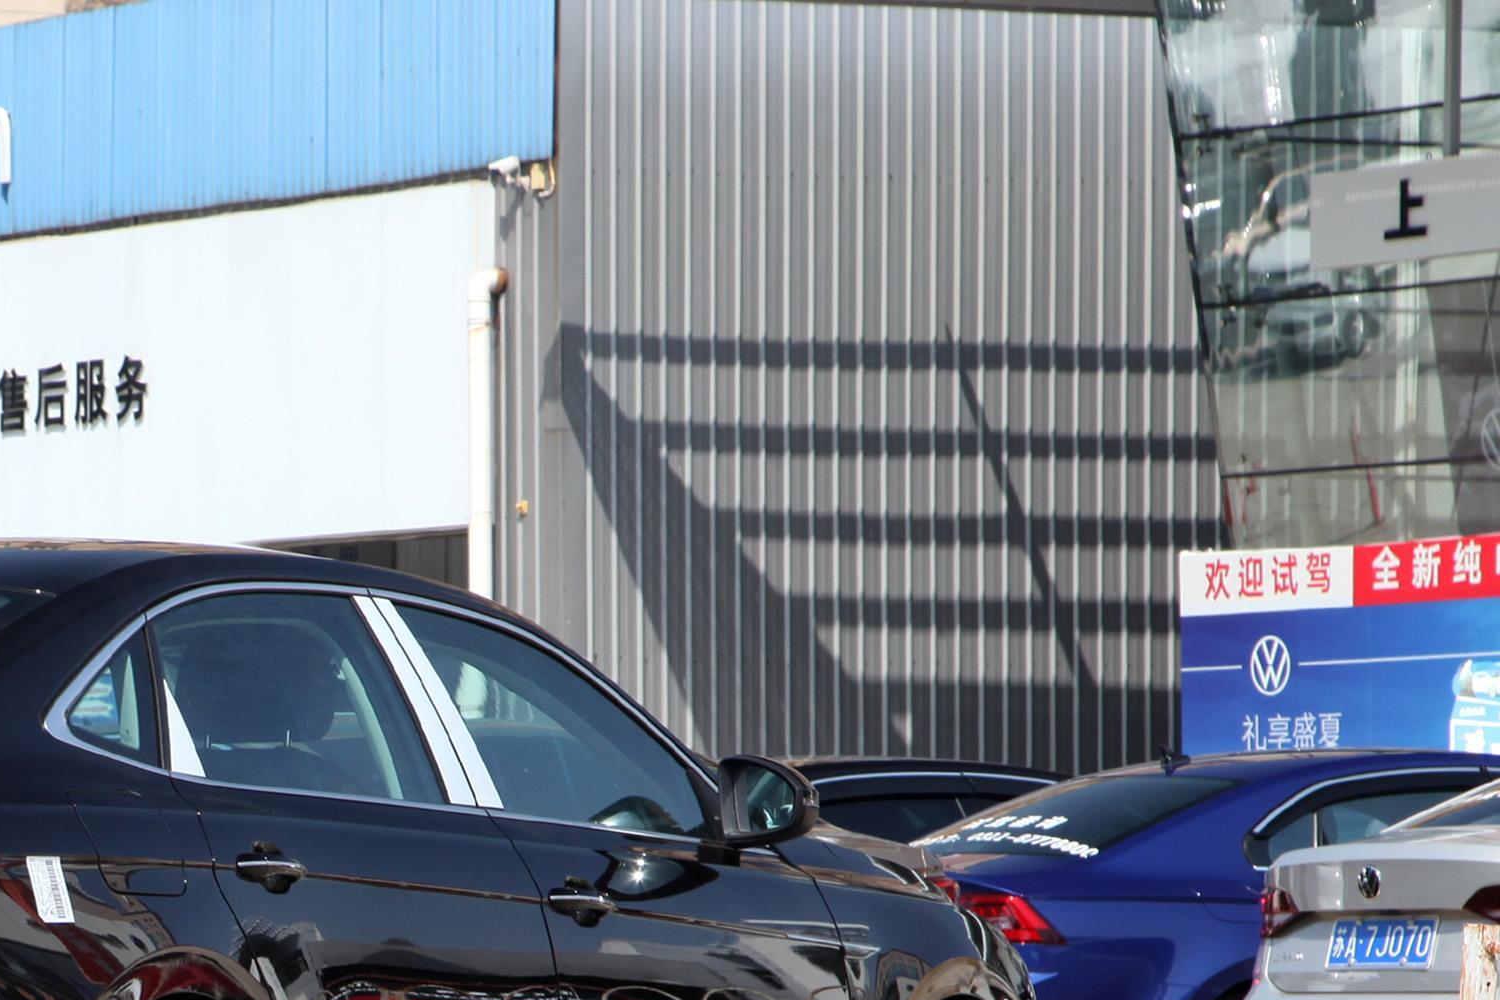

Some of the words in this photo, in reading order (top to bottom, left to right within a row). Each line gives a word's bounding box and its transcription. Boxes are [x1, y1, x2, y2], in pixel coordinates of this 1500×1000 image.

[1384, 177, 1428, 241] 上
[1204, 552, 1331, 600] 欢迎试驾
[1371, 538, 1500, 590] 全新纯
[1241, 712, 1342, 752] 礼享盛夏
